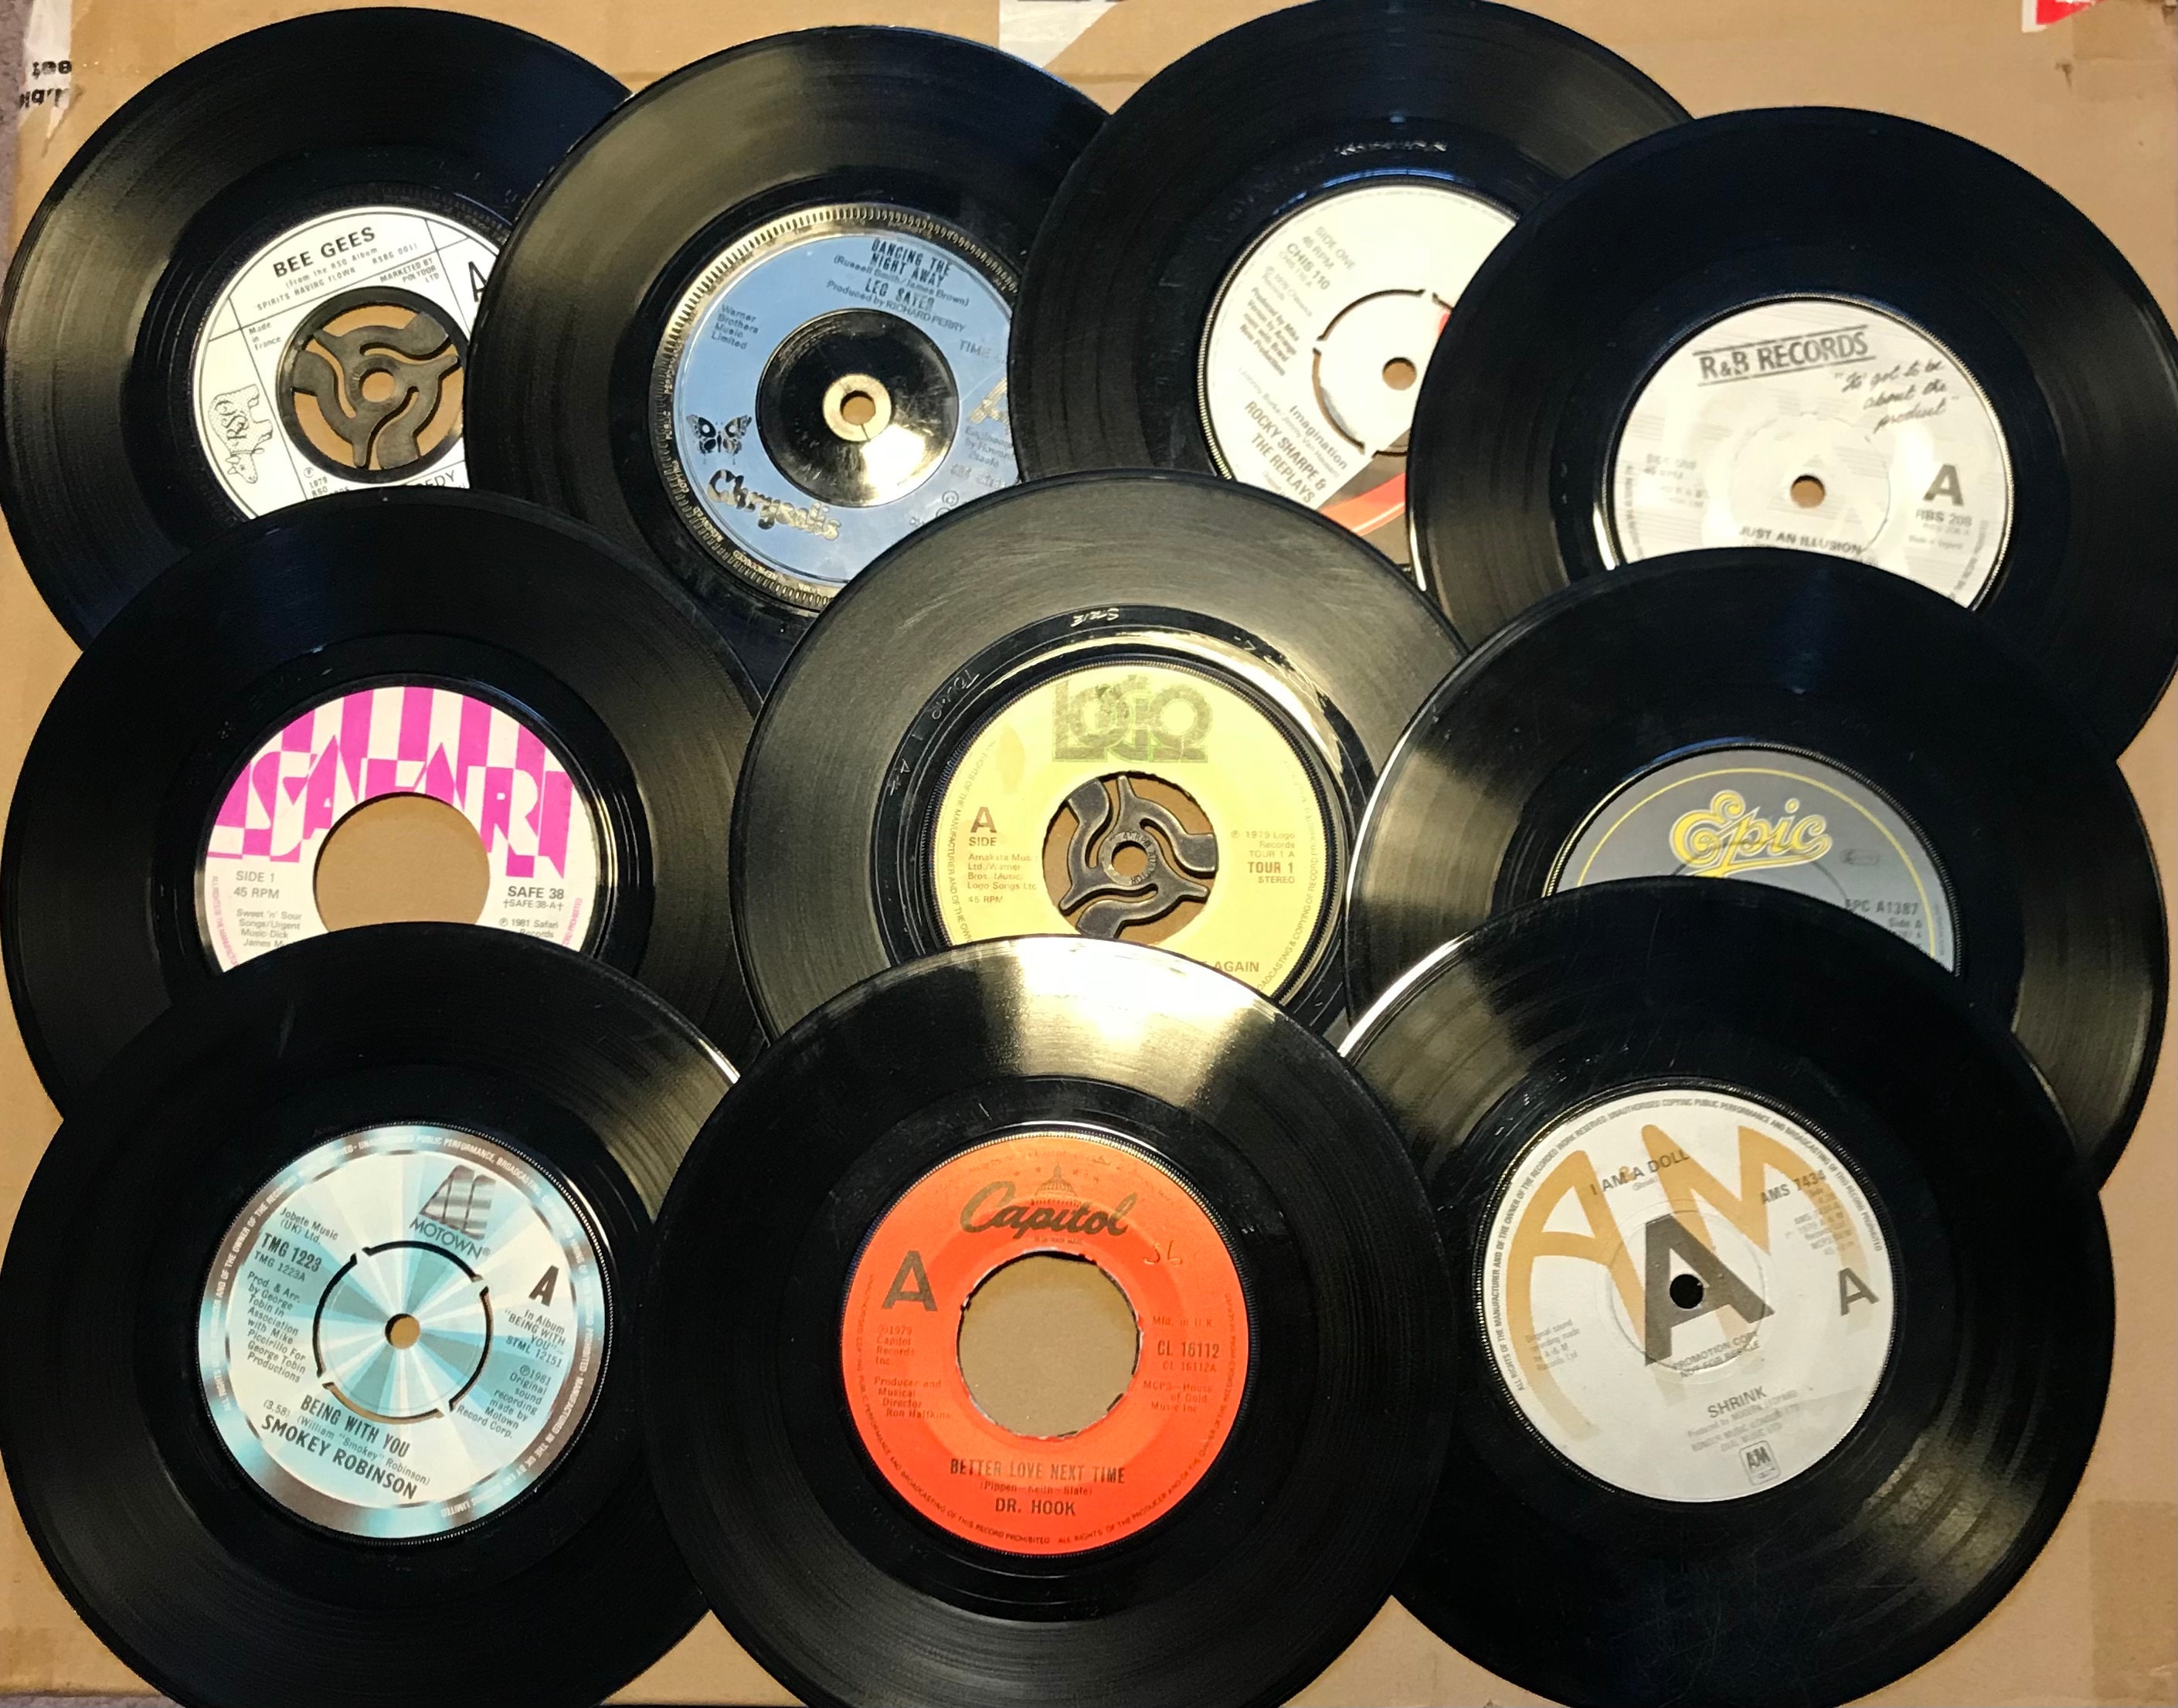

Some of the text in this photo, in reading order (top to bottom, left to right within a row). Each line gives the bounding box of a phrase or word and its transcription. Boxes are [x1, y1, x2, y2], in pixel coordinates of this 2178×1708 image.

[273, 226, 375, 277] BEE GEES
[352, 247, 378, 261] Album
[870, 237, 950, 276] DANCING THE
[379, 257, 433, 284] MARKETED BY
[402, 265, 437, 283] POLYDOR
[425, 273, 440, 284] LTD
[467, 261, 487, 302] A
[870, 253, 946, 287] NIGHT AWAY
[1313, 270, 1330, 290] 110
[257, 267, 356, 311] SPIRITS HAVING FLOWN
[865, 277, 935, 310] LEO SAYER
[722, 304, 756, 323] Warner
[827, 280, 966, 333] Produced by RICHARD PERRY
[249, 321, 271, 335] Made
[714, 323, 744, 338] Music
[717, 314, 759, 334] Brothers
[254, 336, 282, 351] France
[711, 332, 748, 349] Limited
[1700, 331, 1868, 379] R&B RECORDS
[1244, 400, 1327, 491] ROCKY SHARPE &
[1289, 405, 1348, 470] Imagination
[1252, 433, 1315, 503] THE REPLAYS
[309, 476, 328, 490] 1979
[1923, 464, 1964, 507] A
[707, 469, 842, 541] Chrysalis
[1740, 526, 1862, 554] JUST AN ILLUSION
[970, 806, 997, 833] A
[969, 837, 997, 847] SIDE
[1273, 831, 1296, 840] Logo
[1669, 789, 1833, 878] Epic
[236, 871, 275, 883] SIDE 1
[1248, 861, 1293, 874] TOUR 1
[233, 887, 280, 899] 45 RPM
[508, 885, 565, 899] SAFE 38
[992, 882, 1020, 891] Songs
[236, 908, 302, 920] Sweet Sour
[1876, 900, 1918, 915] A1387
[239, 919, 301, 930] Songs/Urgent
[534, 920, 559, 929] Safari
[243, 939, 271, 948] James
[1214, 959, 1259, 973] AGAIN
[1529, 1133, 1576, 1180] RECORDED WORK
[1633, 1166, 1645, 1179] A
[1647, 1149, 1690, 1173] DOLL
[1761, 1184, 1790, 1204] AMS
[960, 1180, 1138, 1239] Capitol
[280, 1207, 338, 1241] Jobete Music
[280, 1219, 302, 1234] (UK)
[231, 1225, 251, 1253] OWNER
[261, 1232, 322, 1272] TMG 1223
[254, 1251, 306, 1282] TMG 1223A
[528, 1265, 559, 1307] A
[882, 1250, 938, 1312] A
[1645, 1213, 1775, 1367] A
[1838, 1267, 1880, 1316] A
[248, 1283, 293, 1310] by George
[248, 1294, 273, 1312] Tobin
[1490, 1269, 1502, 1326] MANUFACTURER
[247, 1306, 299, 1336] Association
[248, 1319, 294, 1344] with Mike
[535, 1314, 566, 1336] Album
[247, 1329, 306, 1361] Piccirillo For
[540, 1328, 566, 1346] WITH
[1157, 1340, 1219, 1358] CL 16112
[247, 1340, 306, 1374] George Tobin
[505, 1336, 562, 1368] STML 12151
[1673, 1341, 1731, 1370] PROMOTION
[247, 1351, 301, 1383] Productions
[1181, 1362, 1217, 1373] 16112A
[509, 1372, 548, 1395] Original
[515, 1387, 542, 1405] sound
[489, 1400, 528, 1422] made by
[494, 1390, 538, 1416] recording
[1707, 1386, 1767, 1418] SHRINK
[301, 1394, 410, 1458] BEING WITH YOU
[457, 1404, 513, 1439] Record Corp.
[484, 1407, 519, 1429] Motown
[263, 1399, 430, 1486] (3.58) (William Robinson)
[261, 1414, 417, 1500] SMOKEY ROBINSON
[950, 1458, 1126, 1484] BETTER LOVE NEXT TIME
[995, 1497, 1076, 1516] DR. HOOK
